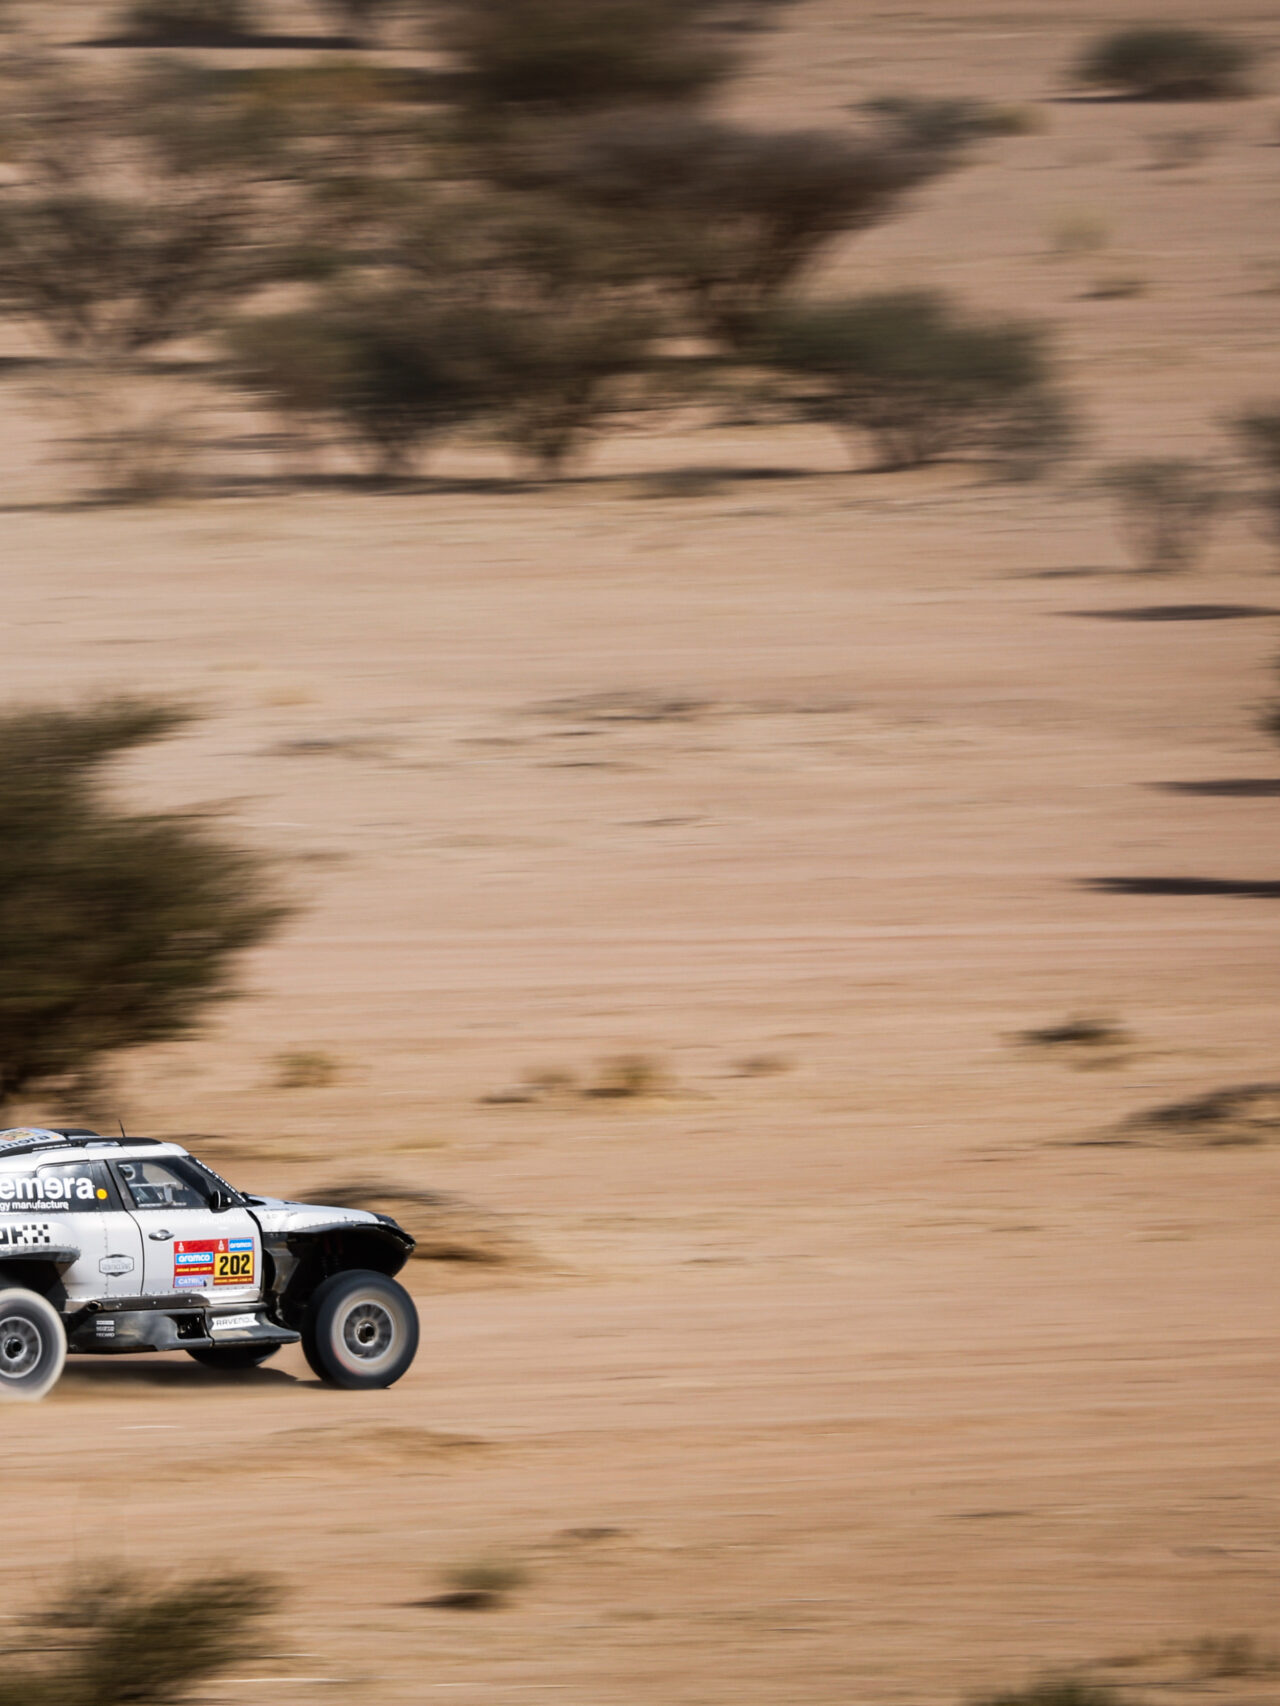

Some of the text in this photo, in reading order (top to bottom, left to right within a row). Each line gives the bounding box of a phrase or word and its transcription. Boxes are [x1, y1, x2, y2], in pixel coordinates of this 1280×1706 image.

[12, 1200, 69, 1210] manufacture
[178, 1254, 211, 1263] aramco
[219, 1254, 250, 1276] 202
